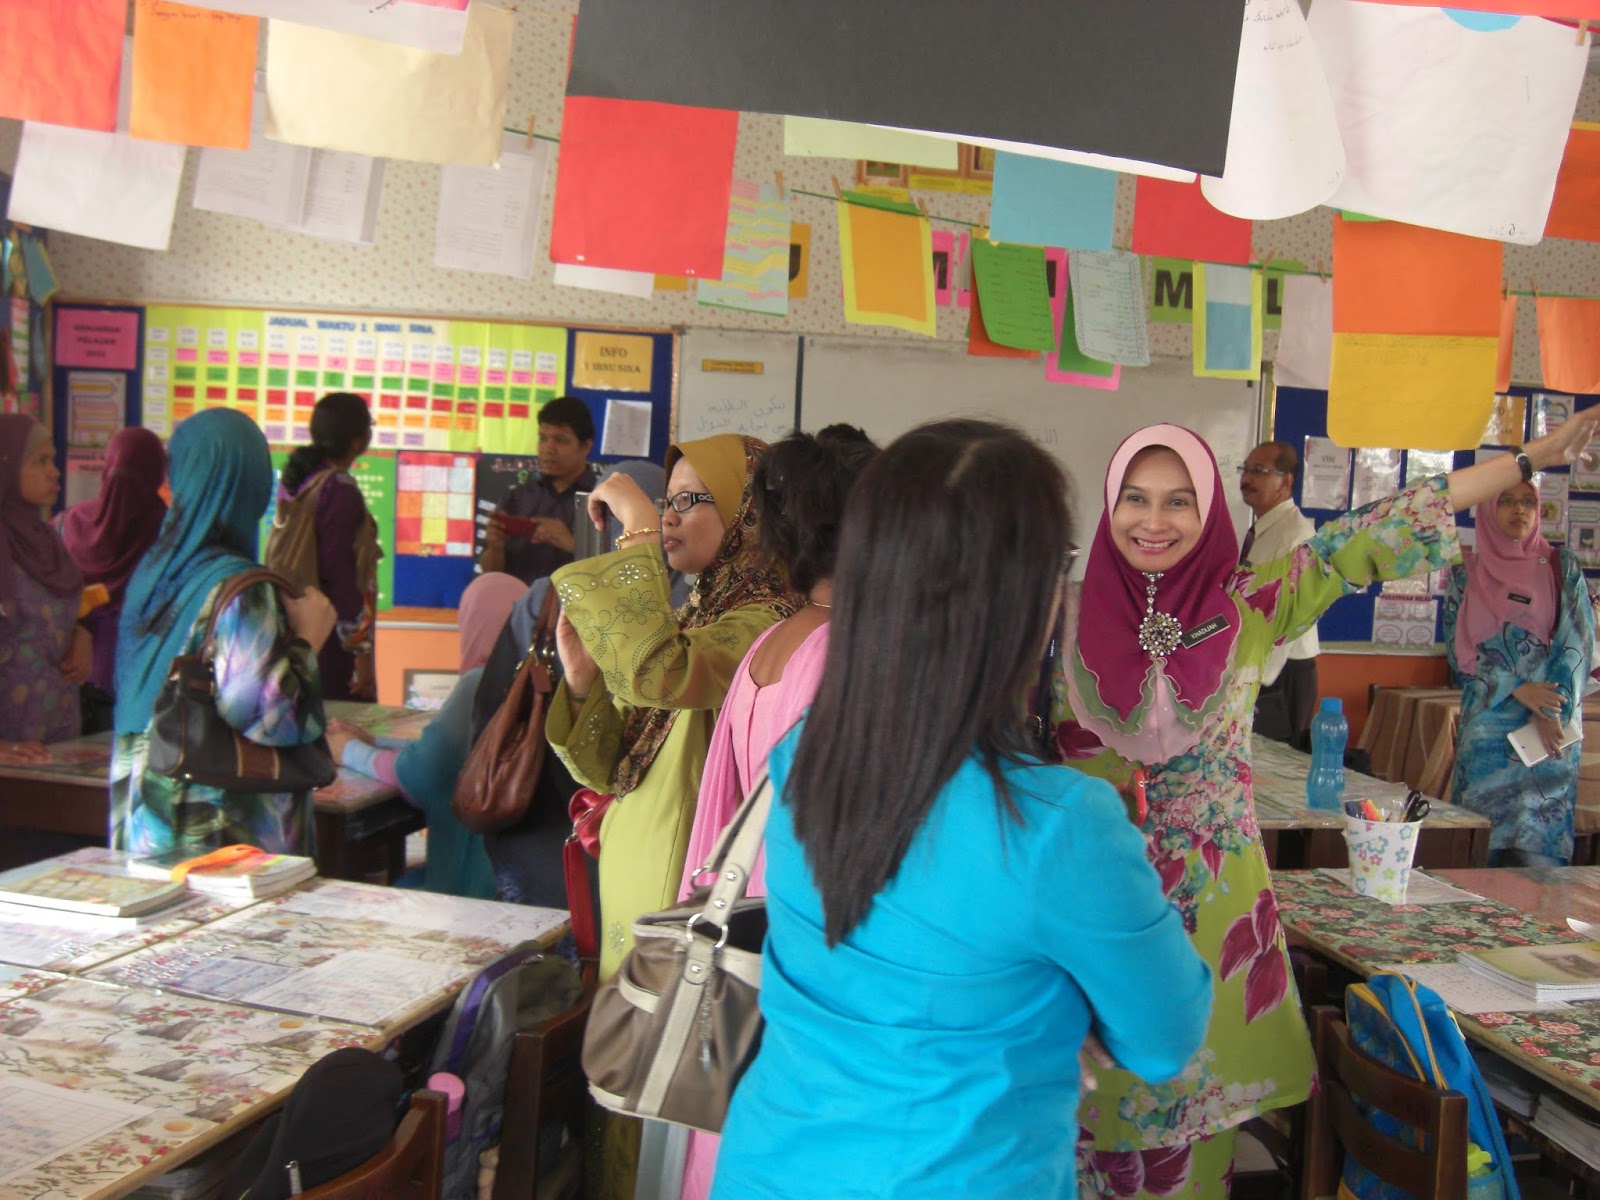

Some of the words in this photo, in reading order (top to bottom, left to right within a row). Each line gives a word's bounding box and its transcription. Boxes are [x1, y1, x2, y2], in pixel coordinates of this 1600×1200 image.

[268, 317, 309, 329] JADUAL
[316, 320, 356, 332] WAKTU
[374, 323, 402, 334] IBNU
[409, 323, 435, 335] SINA
[600, 346, 628, 358] INFO
[593, 362, 615, 372] IBNU
[618, 364, 641, 374] SINA
